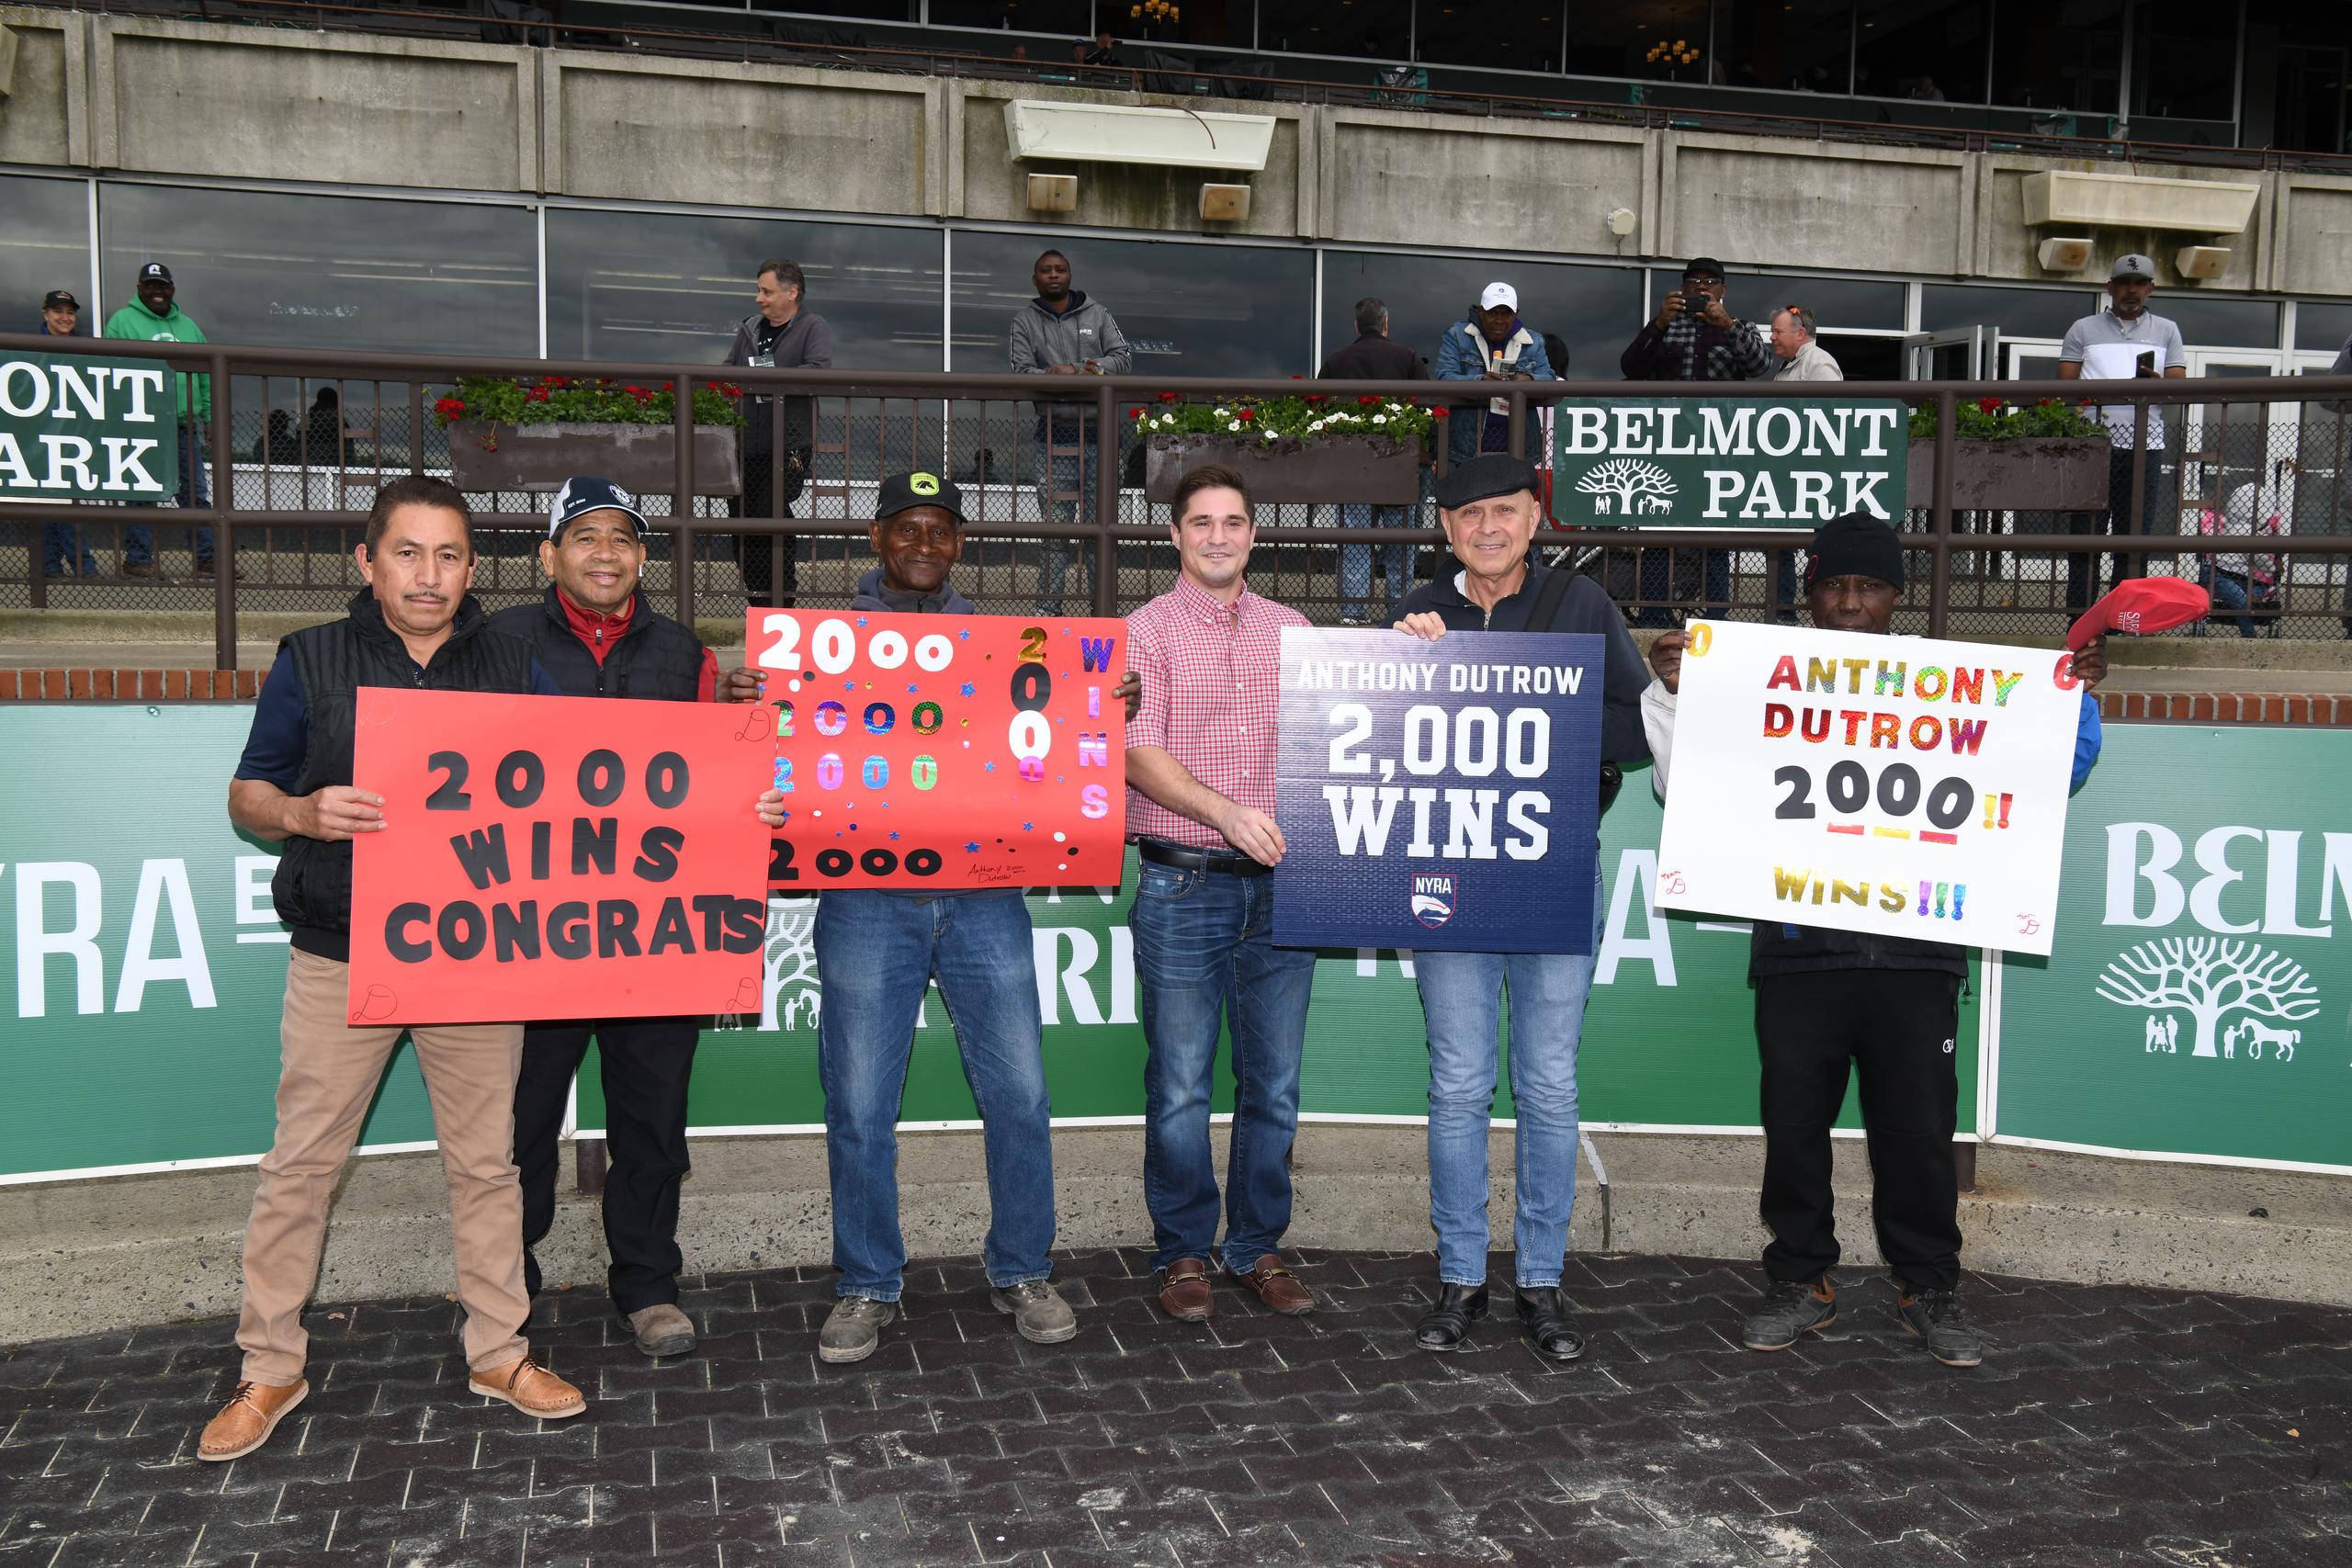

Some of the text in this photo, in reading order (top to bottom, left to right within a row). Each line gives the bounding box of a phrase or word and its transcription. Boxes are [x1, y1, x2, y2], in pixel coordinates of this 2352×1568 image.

[0, 361, 164, 423] ONT
[1565, 407, 1897, 457] BELMONT
[1702, 470, 1891, 521] PARK
[758, 614, 954, 674] 2000
[1297, 662, 1584, 694] ANTHONY DUTROW
[1766, 655, 2024, 706] ANTHONY
[1079, 637, 1115, 819] WINS
[1329, 704, 1551, 783] 2,000
[1763, 703, 1989, 756] DUTROW
[425, 749, 690, 810] 2000
[774, 753, 938, 793] 2000
[1323, 786, 1551, 860] WINS
[449, 818, 685, 890] WINS
[767, 838, 943, 881] 2000
[1415, 876, 1452, 894] NYRA
[0, 855, 218, 1018] RA
[384, 894, 764, 964] CONGRATS
